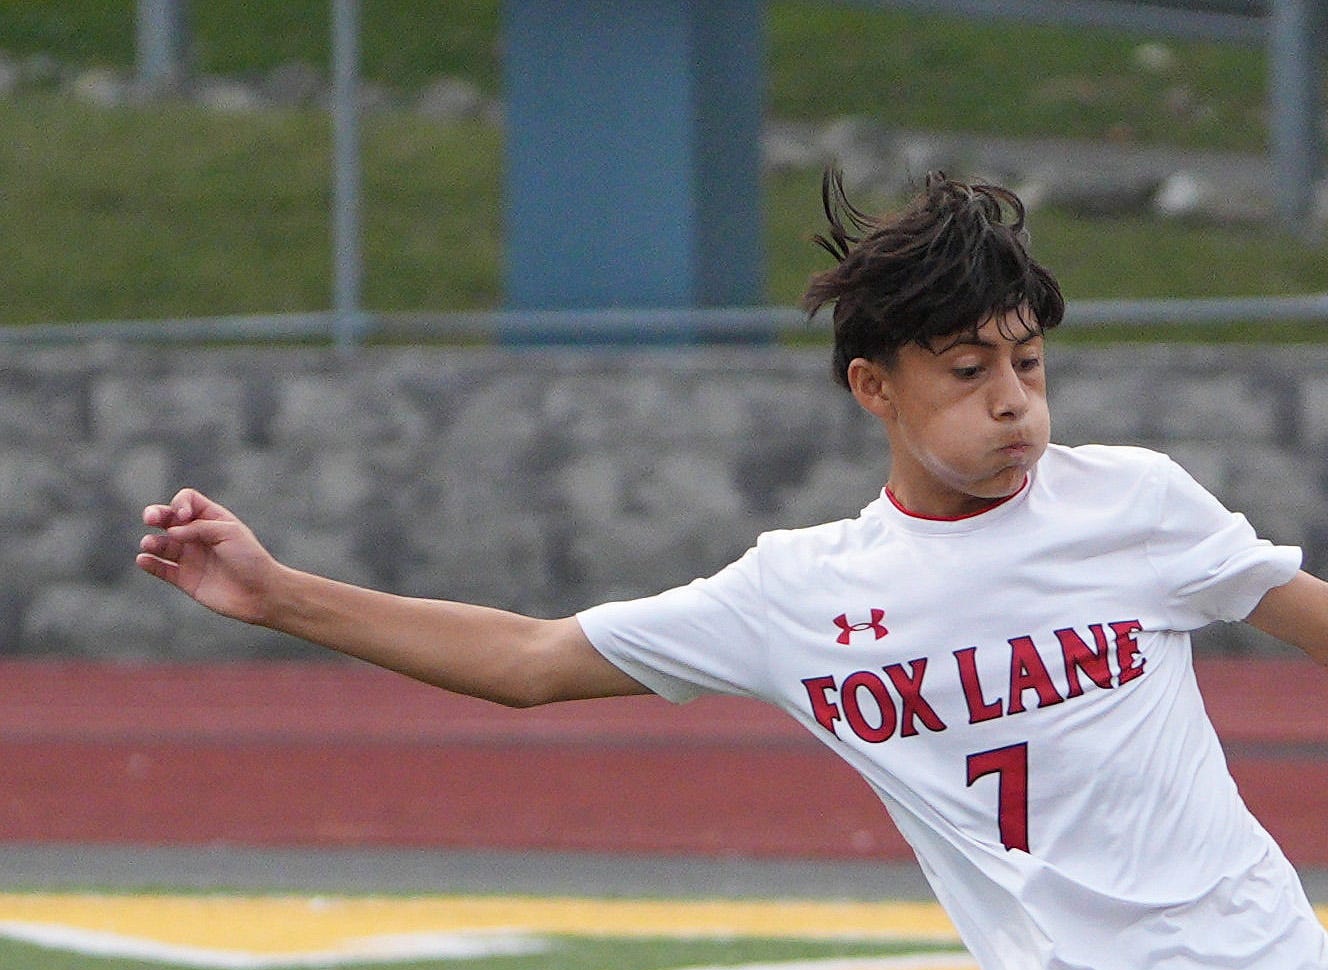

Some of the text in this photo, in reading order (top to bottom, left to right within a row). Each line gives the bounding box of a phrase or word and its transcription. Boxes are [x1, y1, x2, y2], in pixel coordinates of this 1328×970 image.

[801, 618, 1148, 744] FOX LANE
[965, 740, 1032, 855] 7
